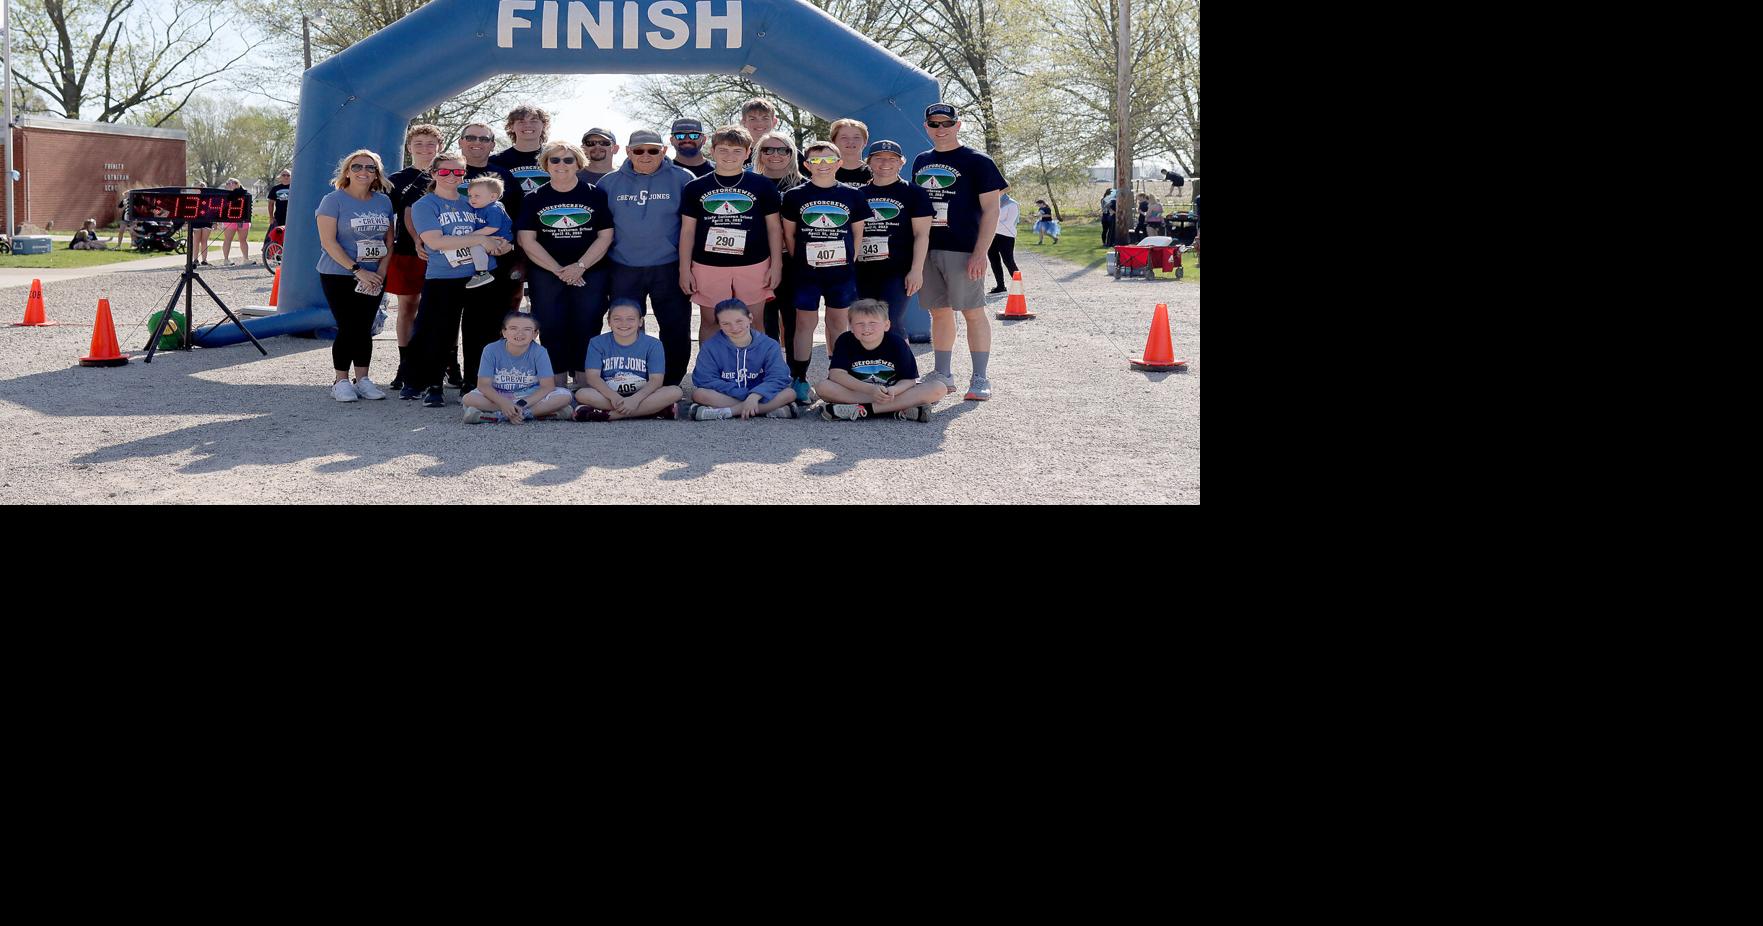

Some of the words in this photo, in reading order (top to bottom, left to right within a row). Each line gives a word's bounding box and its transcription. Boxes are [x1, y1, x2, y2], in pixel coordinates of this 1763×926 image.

[497, 0, 743, 49] FINISH
[616, 194, 638, 202] CREWE
[715, 236, 735, 247] 290
[863, 244, 879, 254] 343
[817, 250, 835, 260] 407
[500, 375, 528, 384] CREWE
[617, 383, 637, 394] 405
